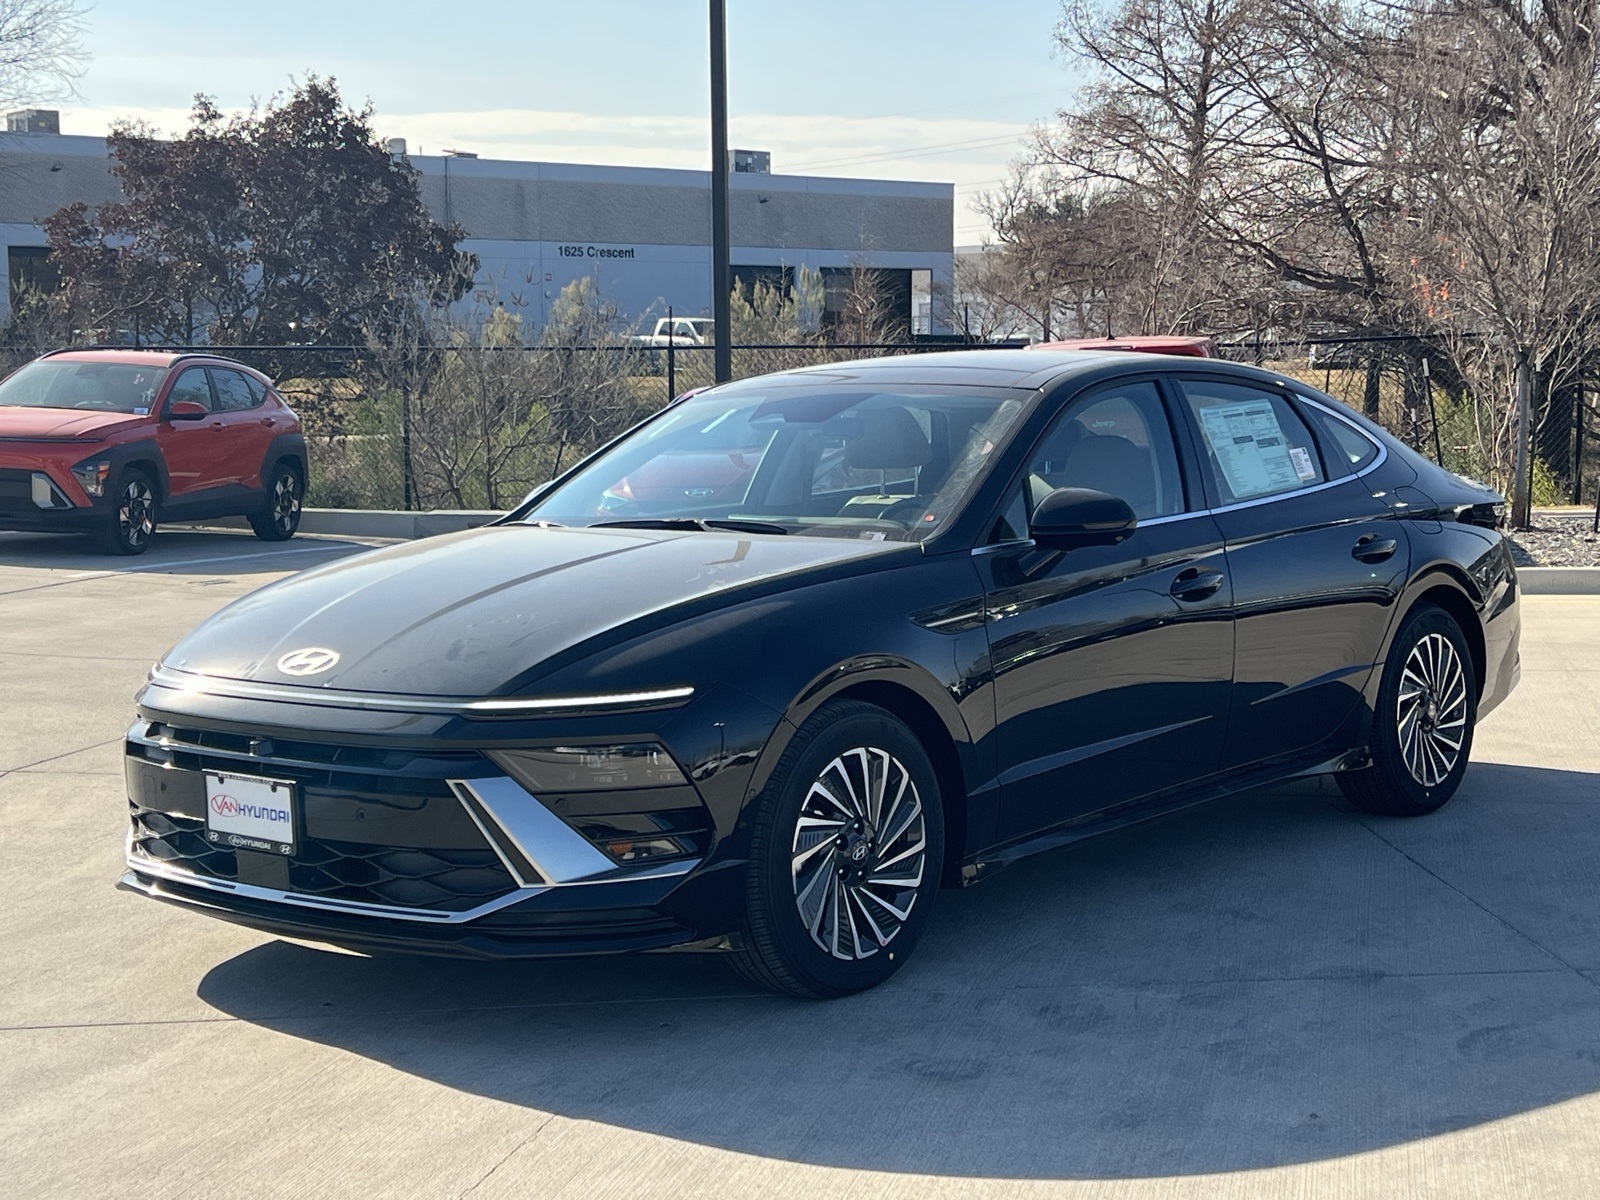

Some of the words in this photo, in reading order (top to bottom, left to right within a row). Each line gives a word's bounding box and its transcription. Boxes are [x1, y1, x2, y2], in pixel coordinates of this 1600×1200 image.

[558, 245, 583, 257] 1625
[587, 246, 635, 258] Crescent
[239, 803, 290, 823] HYUNDAI
